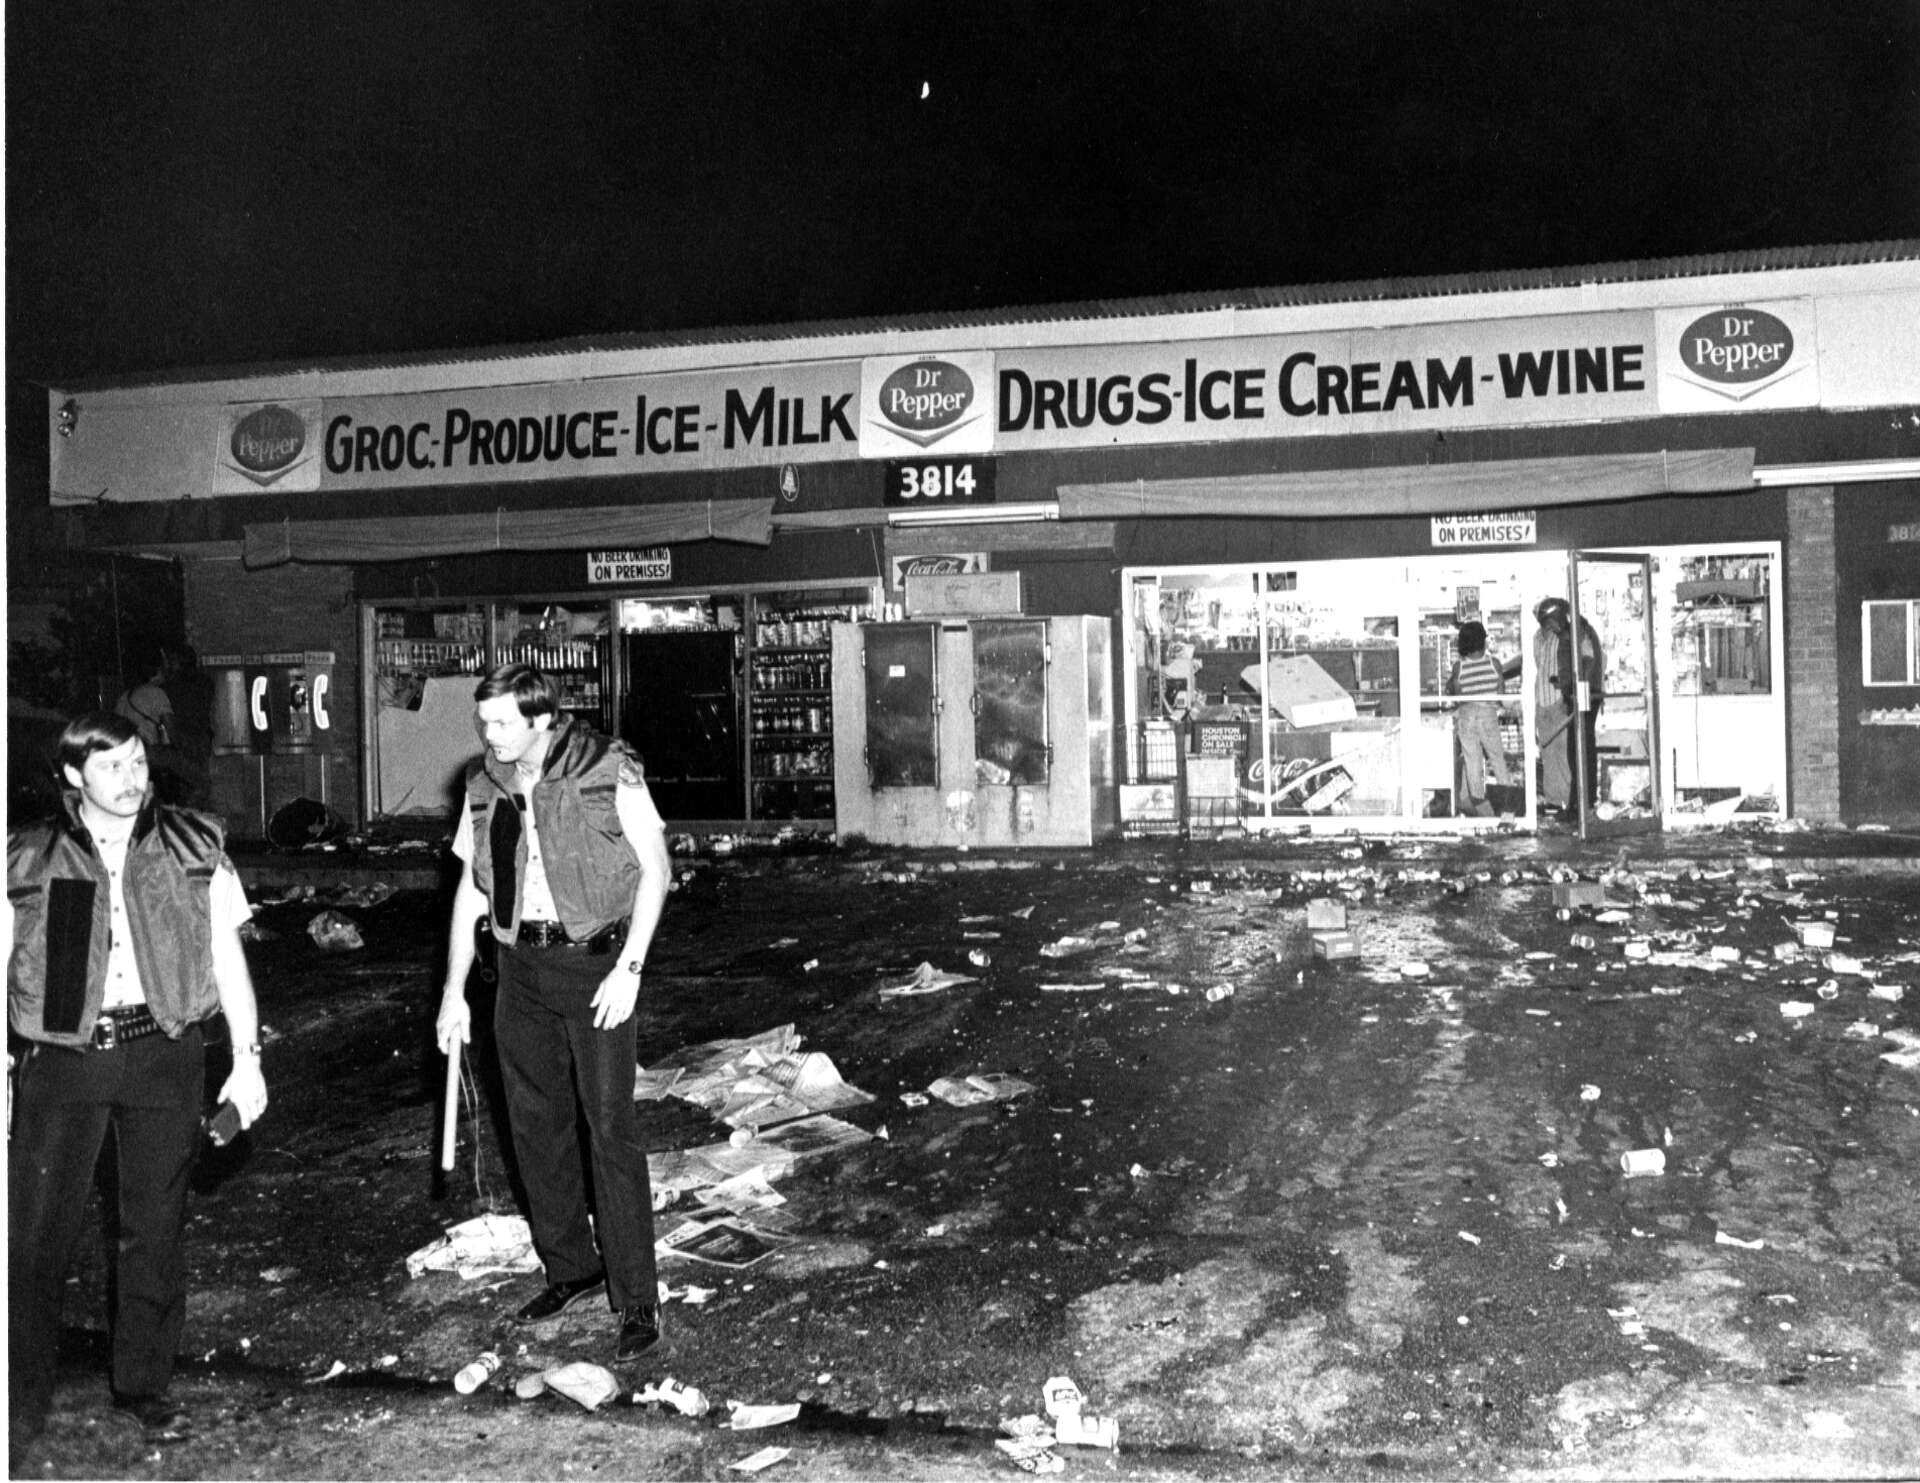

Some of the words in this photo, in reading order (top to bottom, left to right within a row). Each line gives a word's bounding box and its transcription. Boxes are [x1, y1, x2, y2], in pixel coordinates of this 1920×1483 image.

[1721, 316, 1754, 338] Dr
[1694, 337, 1785, 373] Pepper
[915, 368, 942, 389] Dr
[890, 387, 966, 420] Pepper
[899, 464, 977, 498] 3814
[1439, 527, 1456, 543] ON
[1460, 525, 1531, 542] PREMISES!
[594, 565, 611, 580] ON
[615, 563, 670, 579] PREMISES!
[1201, 727, 1241, 735] HOUSTON
